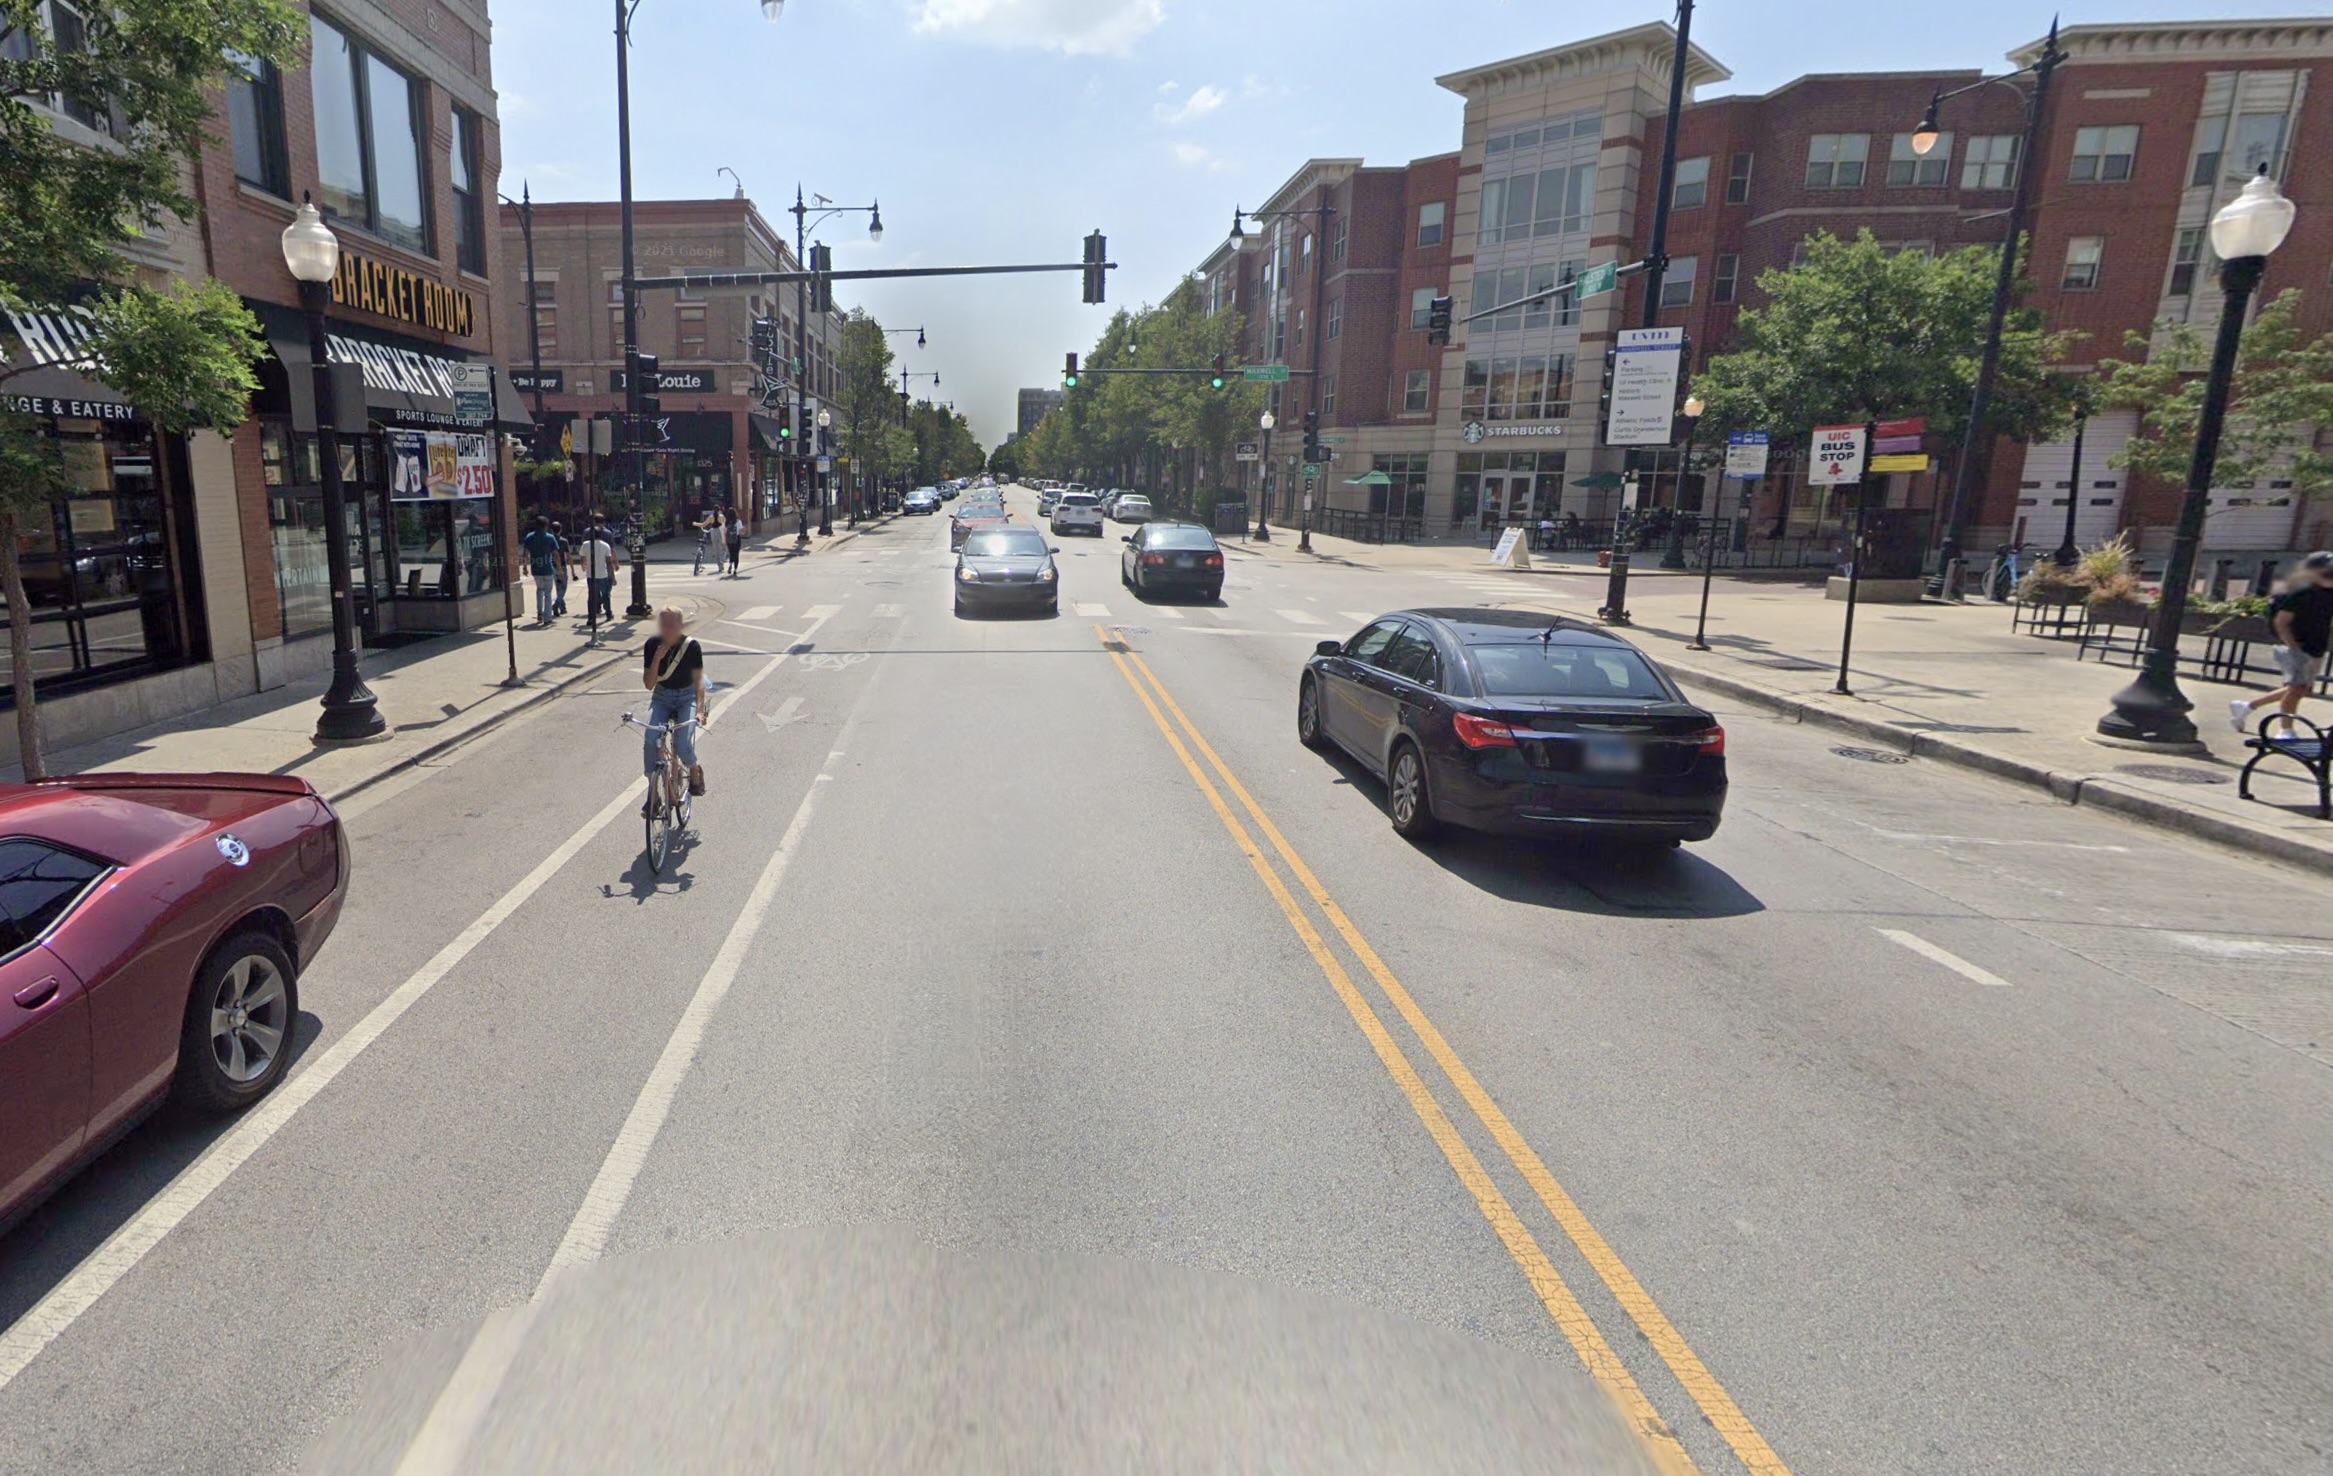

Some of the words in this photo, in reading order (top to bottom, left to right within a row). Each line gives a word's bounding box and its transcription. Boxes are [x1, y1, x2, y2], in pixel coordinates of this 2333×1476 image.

[332, 251, 418, 324] BRACKET
[1246, 367, 1277, 375] MAXWELL
[658, 374, 701, 388] Louie
[52, 400, 64, 415] &
[71, 401, 133, 419] EATERY
[396, 410, 425, 421] SPORTS
[427, 414, 454, 425] LOUNGE
[462, 418, 484, 427] EATERY
[1486, 425, 1562, 437] STARBUCKS
[1828, 432, 1851, 441] UIC
[456, 435, 488, 457] DRAFT
[1821, 442, 1855, 451] BUS
[1820, 452, 1855, 462] STOP
[457, 465, 492, 495] $2.50
[471, 533, 493, 548] SCREENS
